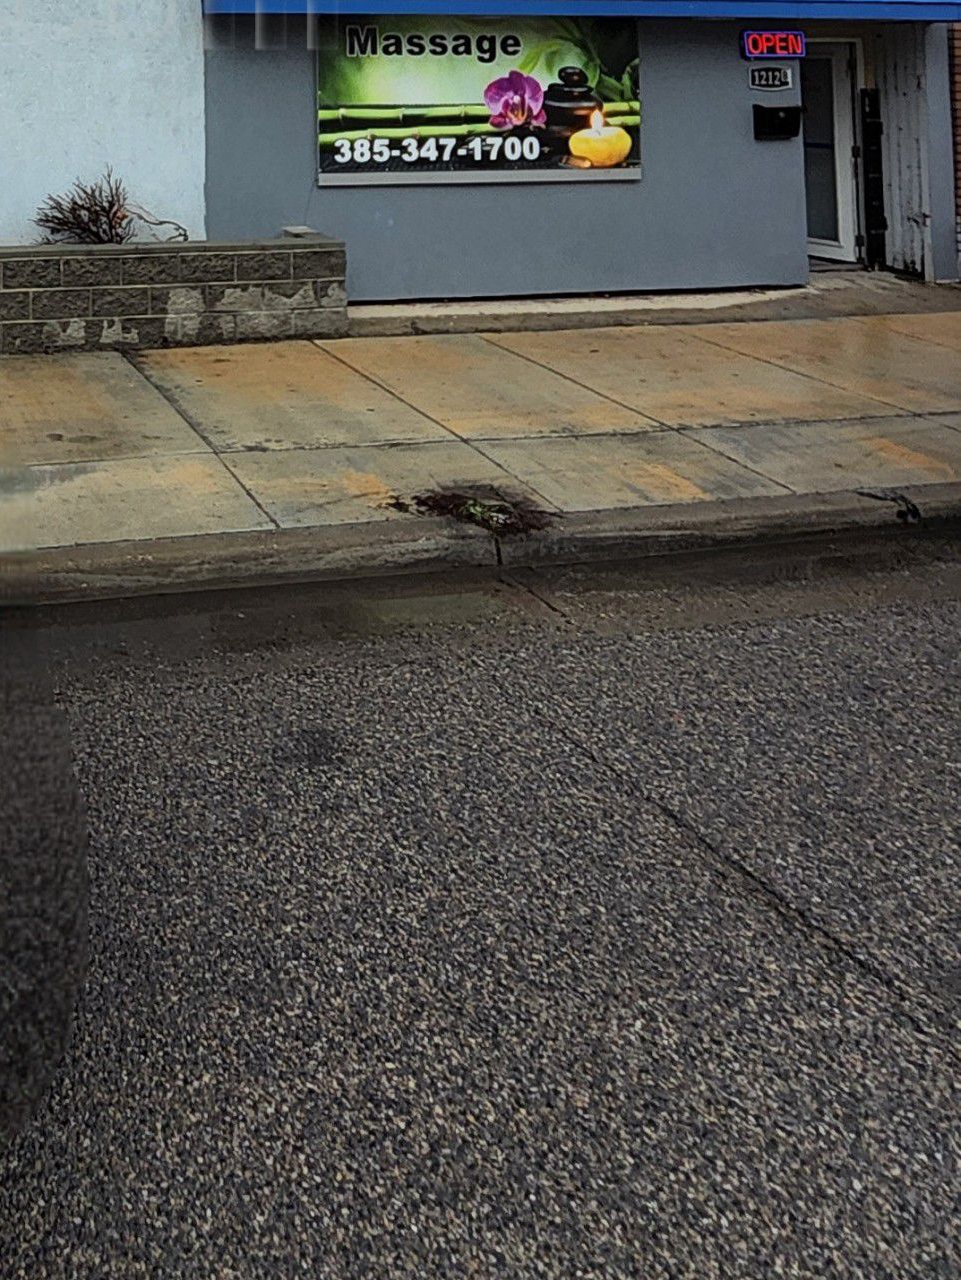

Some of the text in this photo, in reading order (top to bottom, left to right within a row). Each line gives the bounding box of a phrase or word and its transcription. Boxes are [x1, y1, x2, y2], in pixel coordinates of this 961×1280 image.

[345, 23, 523, 63] Massage
[747, 33, 802, 55] OPEN
[334, 136, 541, 163] 385-347-1700
